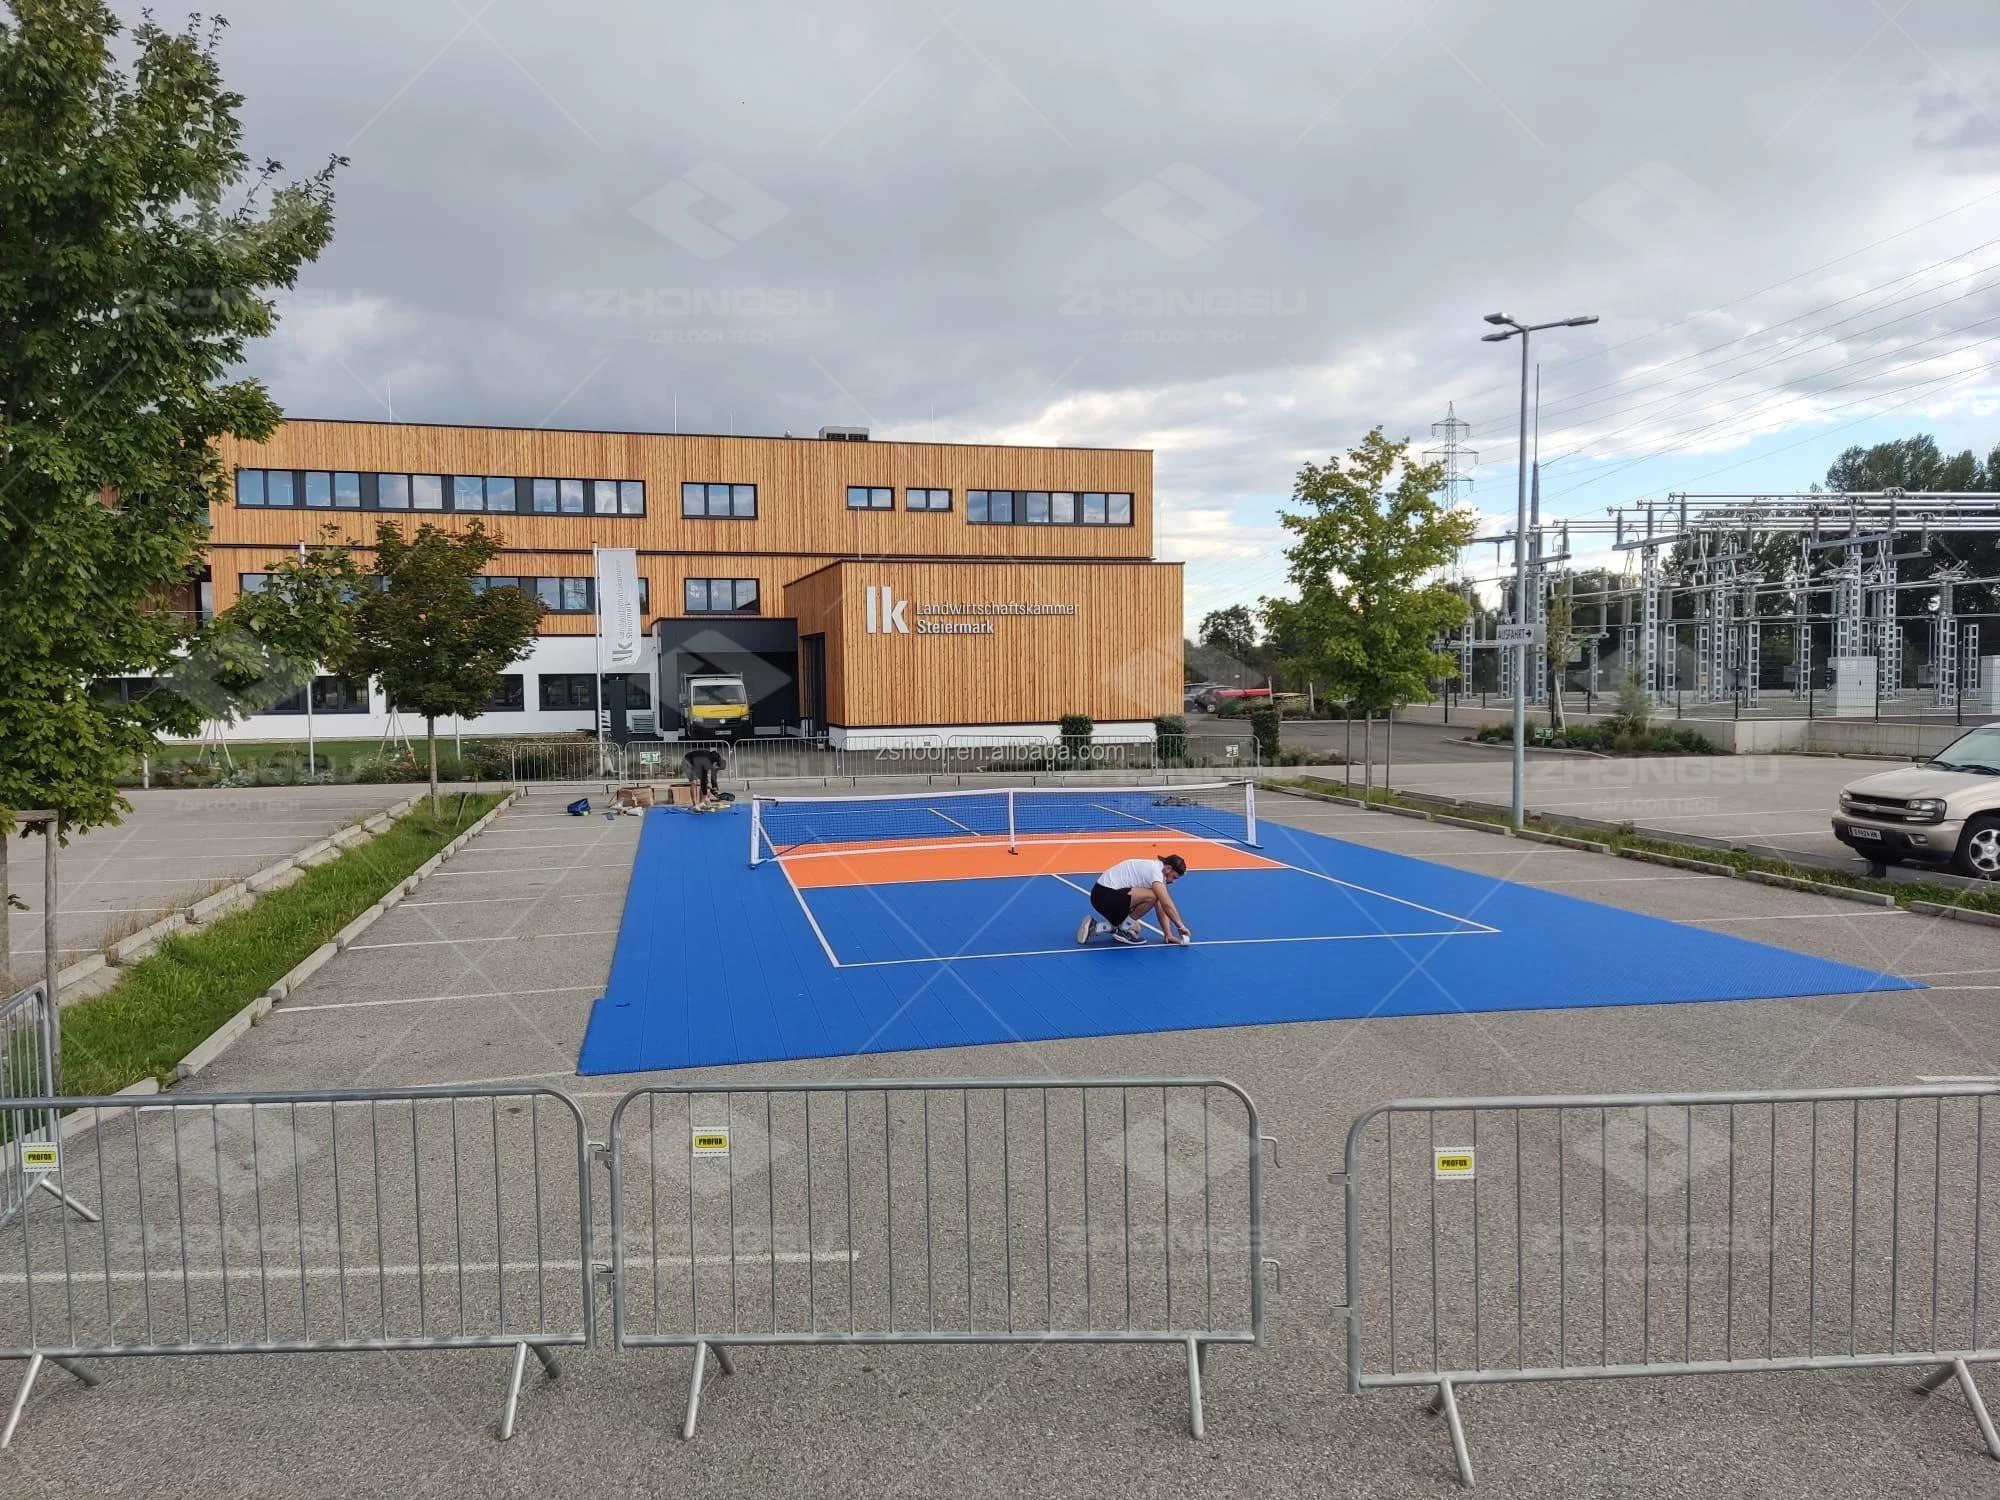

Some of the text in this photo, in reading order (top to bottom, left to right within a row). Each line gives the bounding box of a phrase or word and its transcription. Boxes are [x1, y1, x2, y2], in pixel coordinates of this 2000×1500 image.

[866, 585, 910, 634] lk
[916, 600, 1080, 616] Landwirtschaftskammer
[916, 619, 995, 634] Steiermark
[1498, 628, 1525, 640] AUSFAHRT
[698, 1137, 723, 1145] PROFOX
[27, 1153, 52, 1161] PROFOX
[1441, 1159, 1467, 1168] PROFOX
